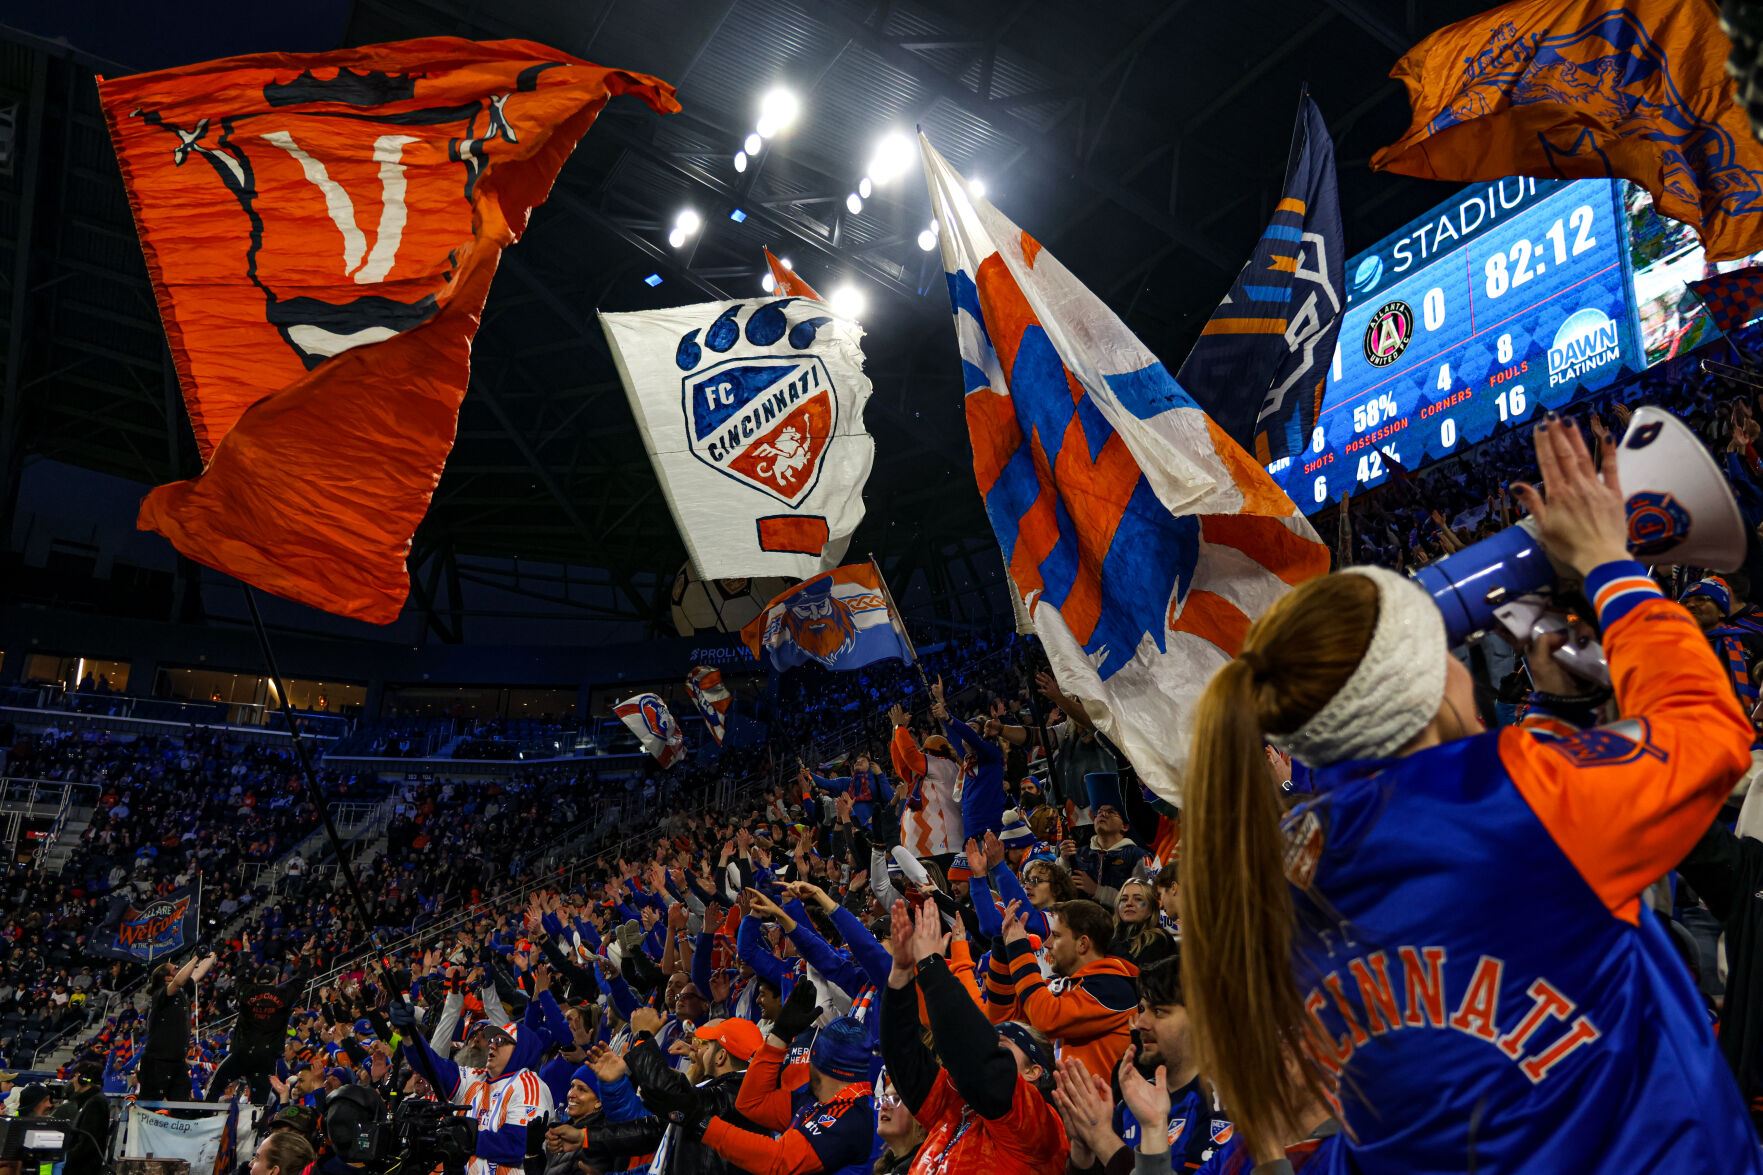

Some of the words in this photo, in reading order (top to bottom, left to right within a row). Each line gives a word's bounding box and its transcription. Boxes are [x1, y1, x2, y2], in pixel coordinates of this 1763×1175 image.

[1485, 205, 1596, 299] 82:12
[1370, 303, 1405, 328] ATLANTA
[1423, 287, 1445, 332] 0
[1370, 352, 1398, 365] UNITED
[1399, 337, 1409, 350] FC
[1548, 320, 1617, 374] DAWN
[1550, 346, 1620, 388] PLATINUM
[705, 382, 735, 411] FC
[708, 364, 820, 463] CINCINNATI
[1268, 456, 1290, 475] CIN
[1312, 426, 1325, 453] 8
[1353, 390, 1397, 433] 58%
[1437, 362, 1452, 391] 4
[1497, 333, 1513, 364] 8
[1304, 452, 1334, 474] SHOTS
[1345, 417, 1408, 455] POSSESSION
[1420, 387, 1472, 419] CORNERS
[1489, 360, 1528, 387] FOULS
[1314, 475, 1327, 503] 6
[1440, 418, 1456, 448] 0
[1494, 384, 1526, 422] 16
[119, 905, 187, 945] Welcome
[156, 905, 172, 915] ARE
